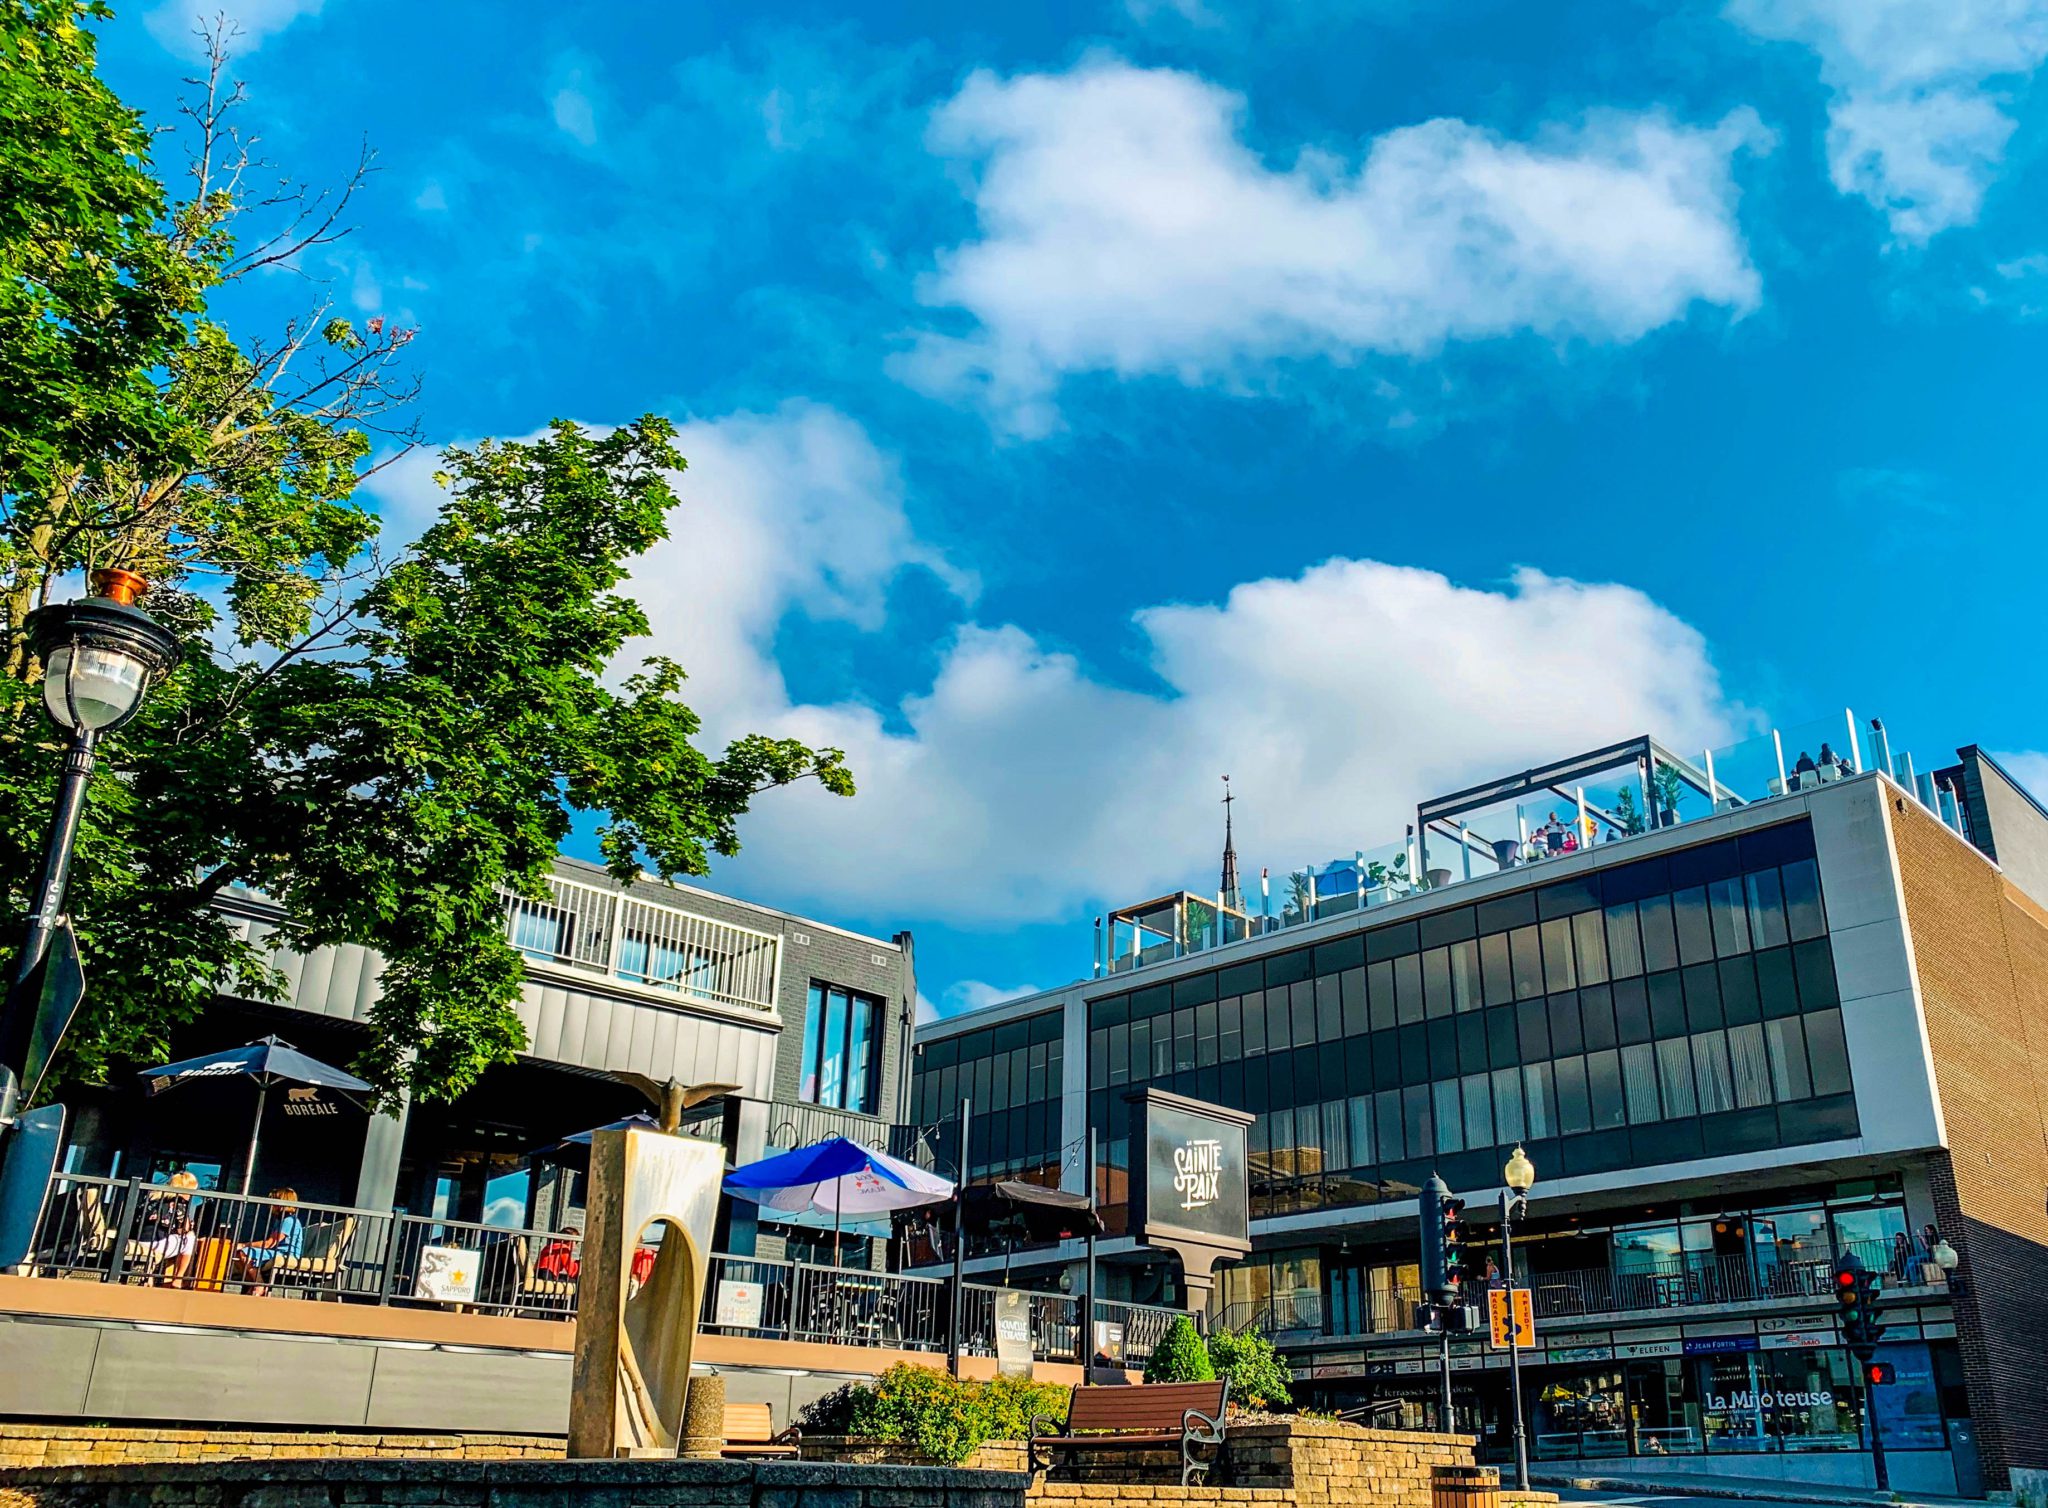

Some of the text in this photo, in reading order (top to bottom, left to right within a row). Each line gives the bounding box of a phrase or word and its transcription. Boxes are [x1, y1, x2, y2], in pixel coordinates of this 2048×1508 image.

[441, 1284, 471, 1294] SAPPORO
[1491, 1292, 1500, 1344] MAGASINER
[1639, 1345, 1670, 1354] ELEFEN
